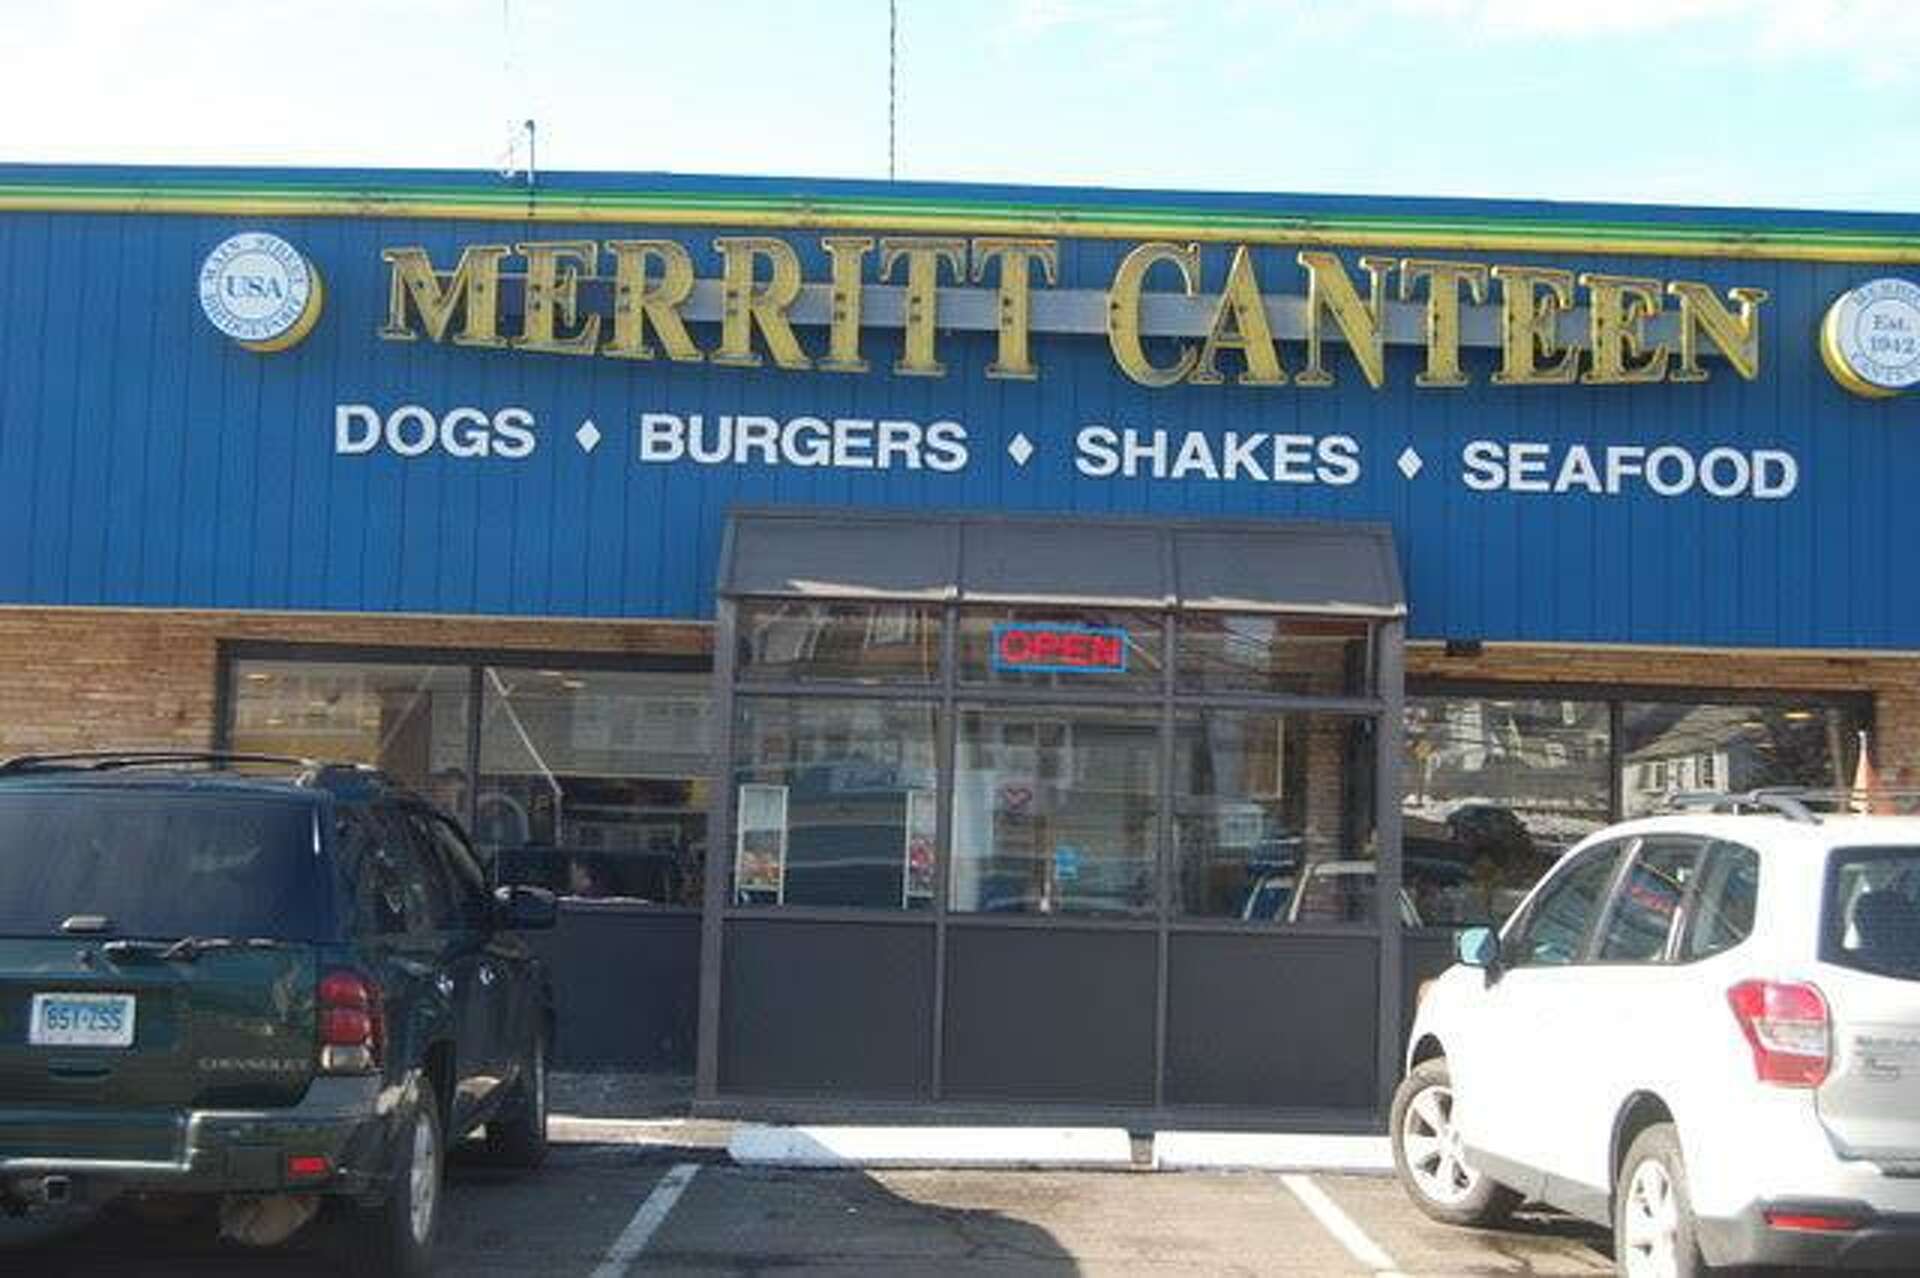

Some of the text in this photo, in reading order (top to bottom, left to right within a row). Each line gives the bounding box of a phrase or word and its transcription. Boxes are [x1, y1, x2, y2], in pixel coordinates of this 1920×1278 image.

[226, 275, 283, 299] USA
[379, 236, 1768, 389] MERRITT CANTEEN
[1871, 335, 1916, 354] 1942
[335, 404, 1799, 499] DOGS BURGERS SHAKES SEAFOOD
[1001, 631, 1121, 666] OPEN
